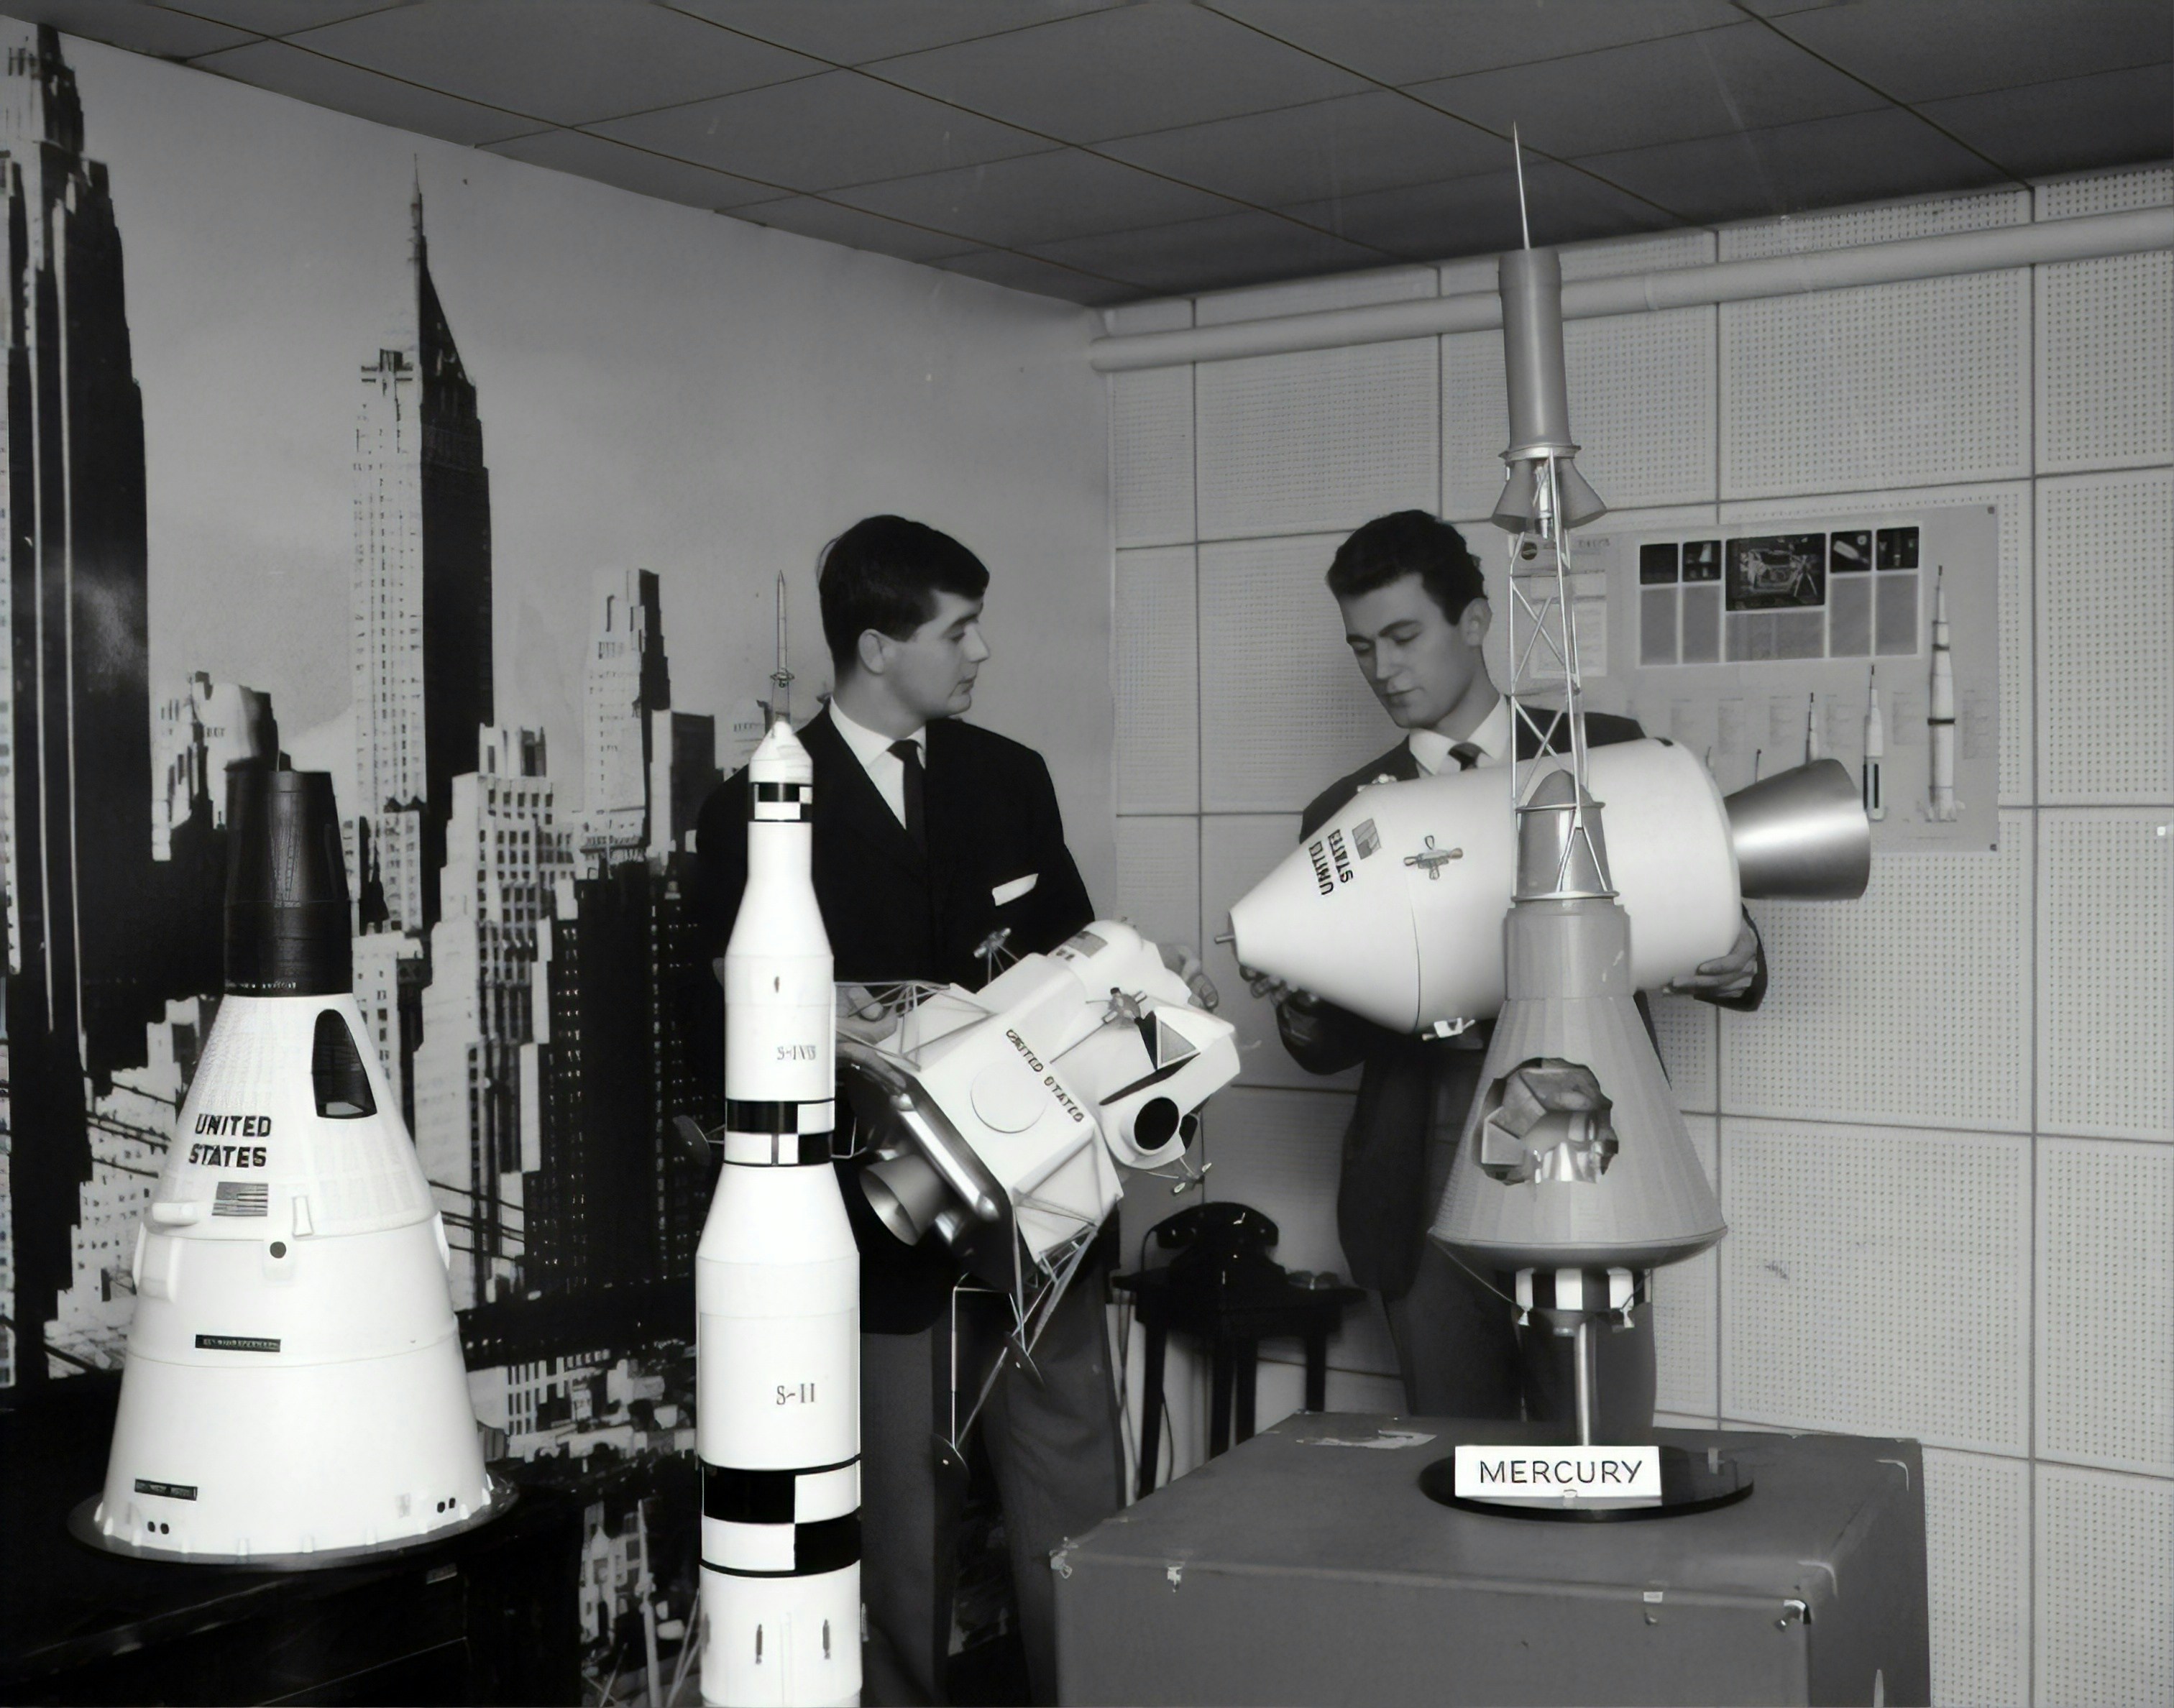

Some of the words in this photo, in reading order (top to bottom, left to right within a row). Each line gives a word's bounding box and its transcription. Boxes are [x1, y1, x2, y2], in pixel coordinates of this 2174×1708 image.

[195, 1114, 272, 1137] UNITED
[188, 1143, 267, 1168] STATES
[1479, 1460, 1643, 1484] MERCURY
